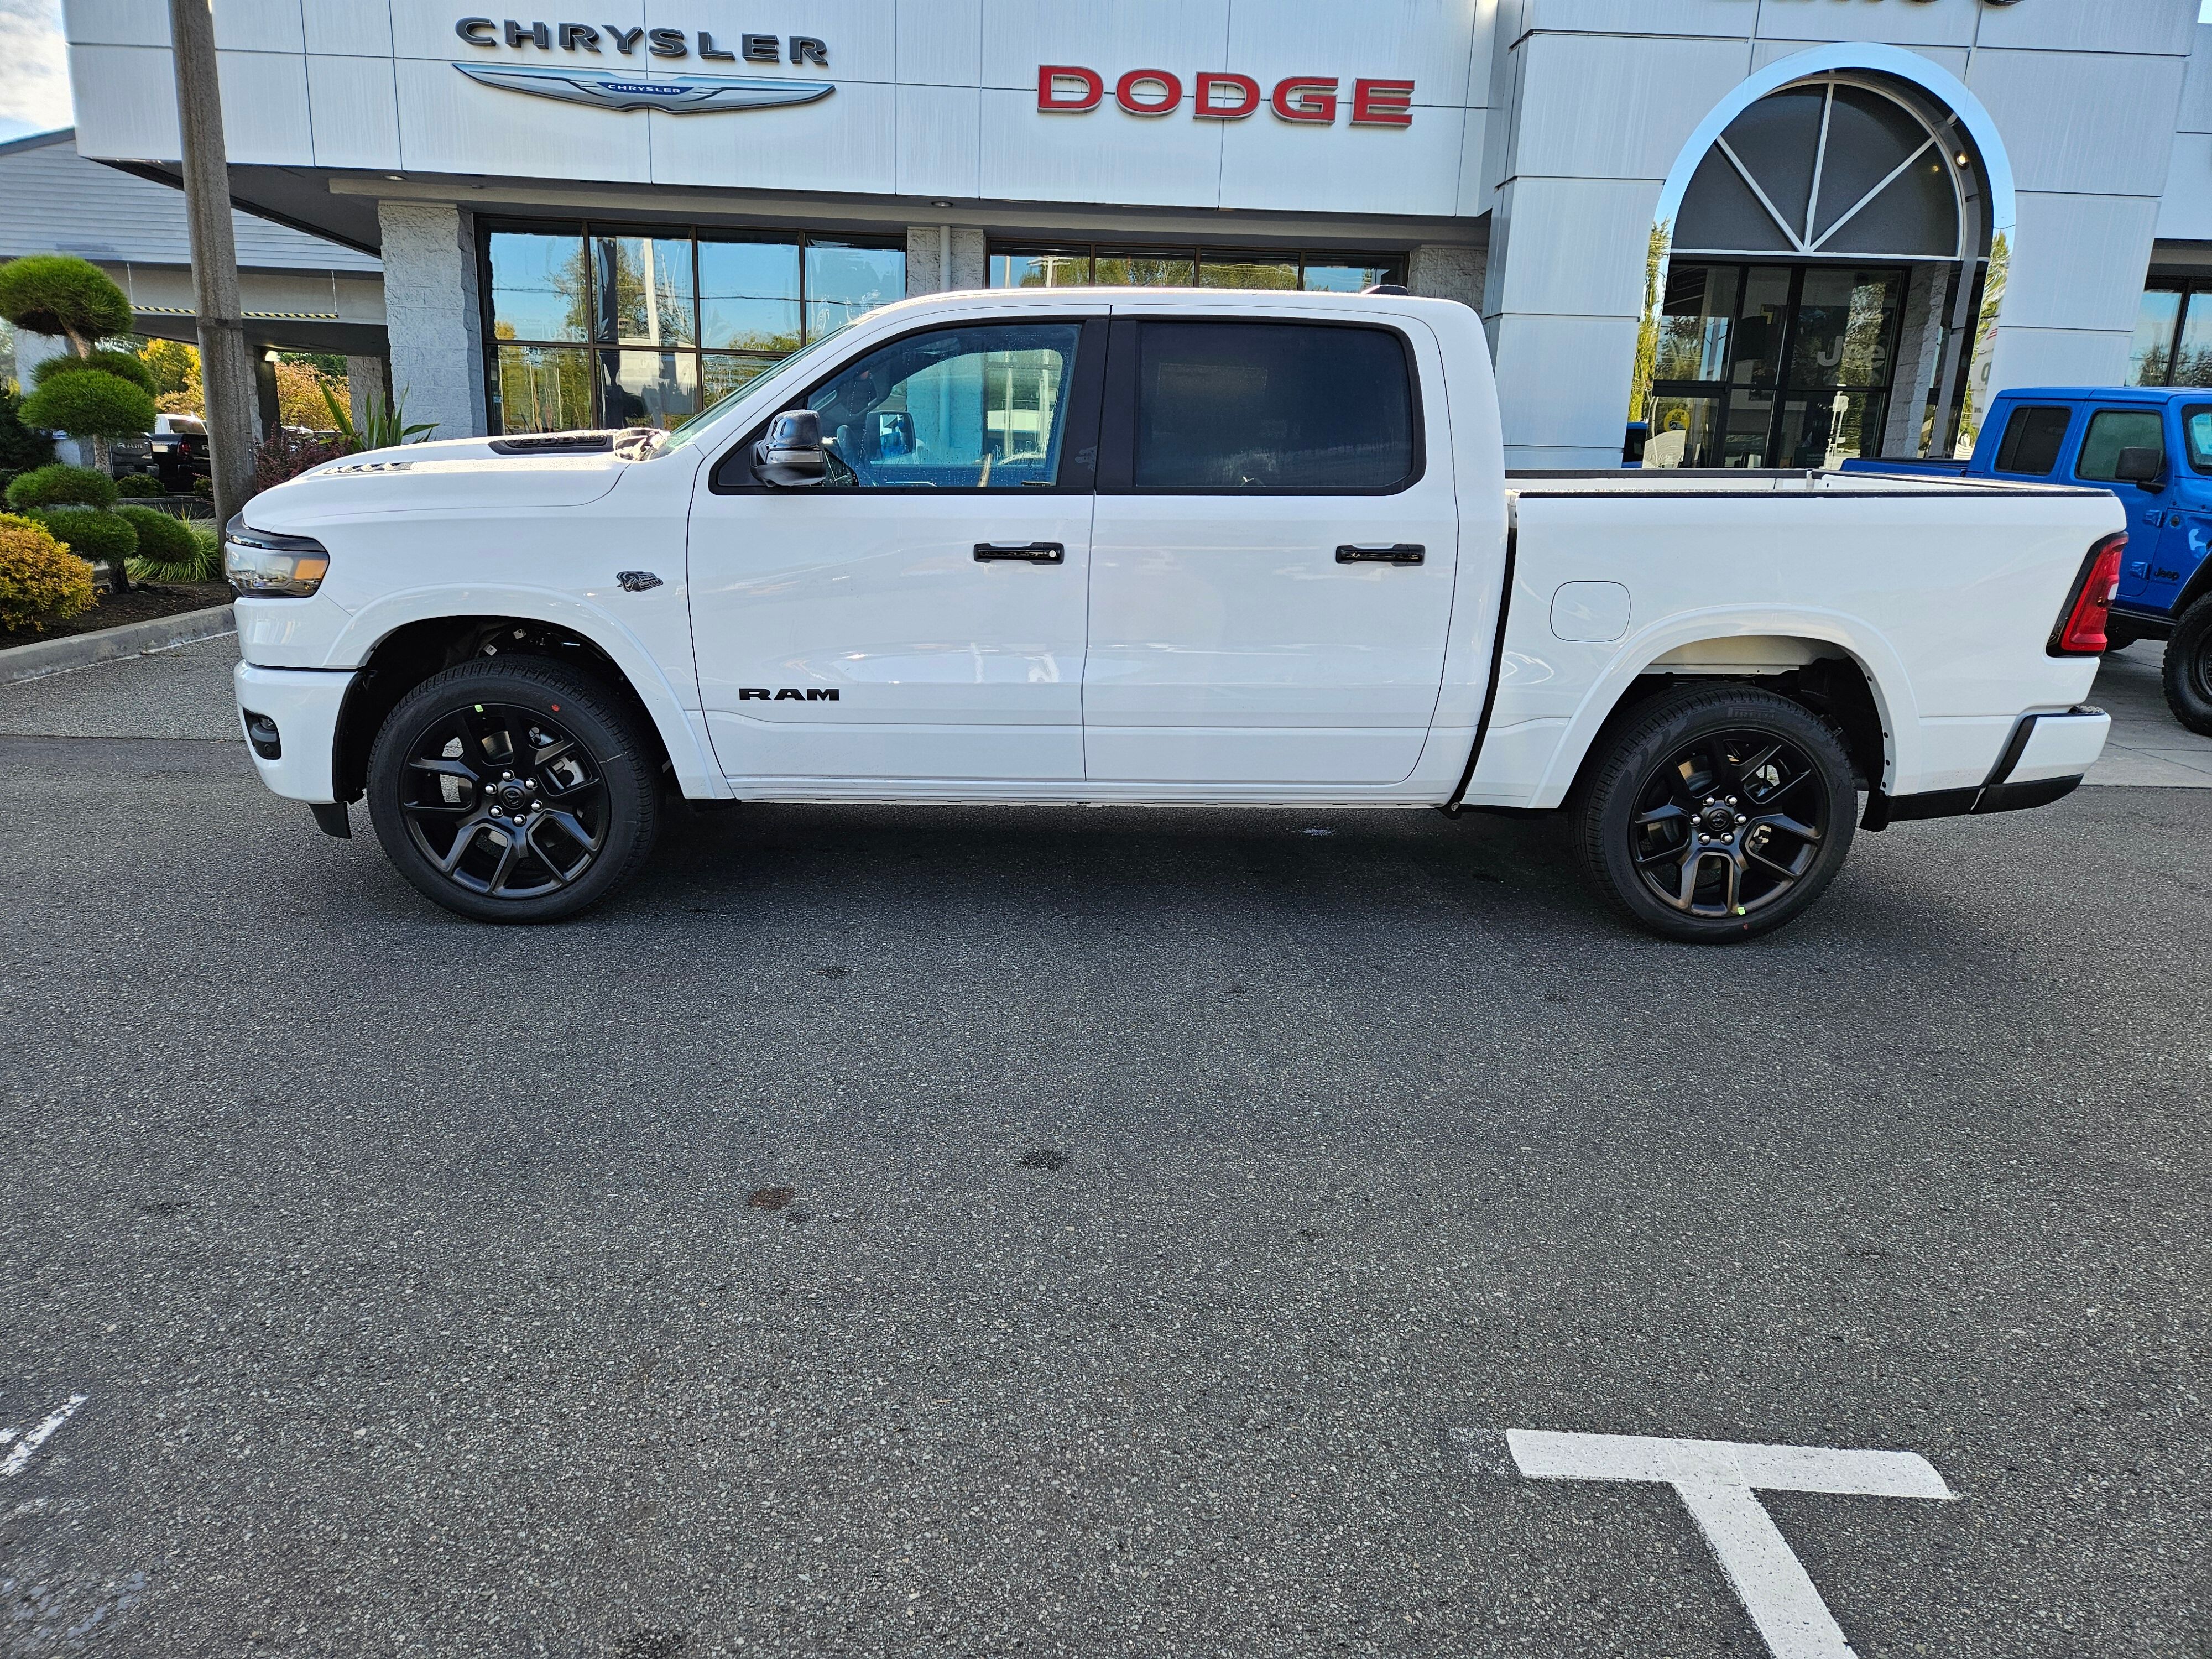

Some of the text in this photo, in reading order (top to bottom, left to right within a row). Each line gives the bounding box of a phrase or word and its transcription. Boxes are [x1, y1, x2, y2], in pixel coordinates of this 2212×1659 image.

[455, 17, 828, 66] CHRYSLER
[608, 85, 681, 93] CHRYSLER
[1037, 65, 1415, 127] DODGE
[2154, 567, 2180, 581] Jeep
[739, 688, 839, 701] RAM
